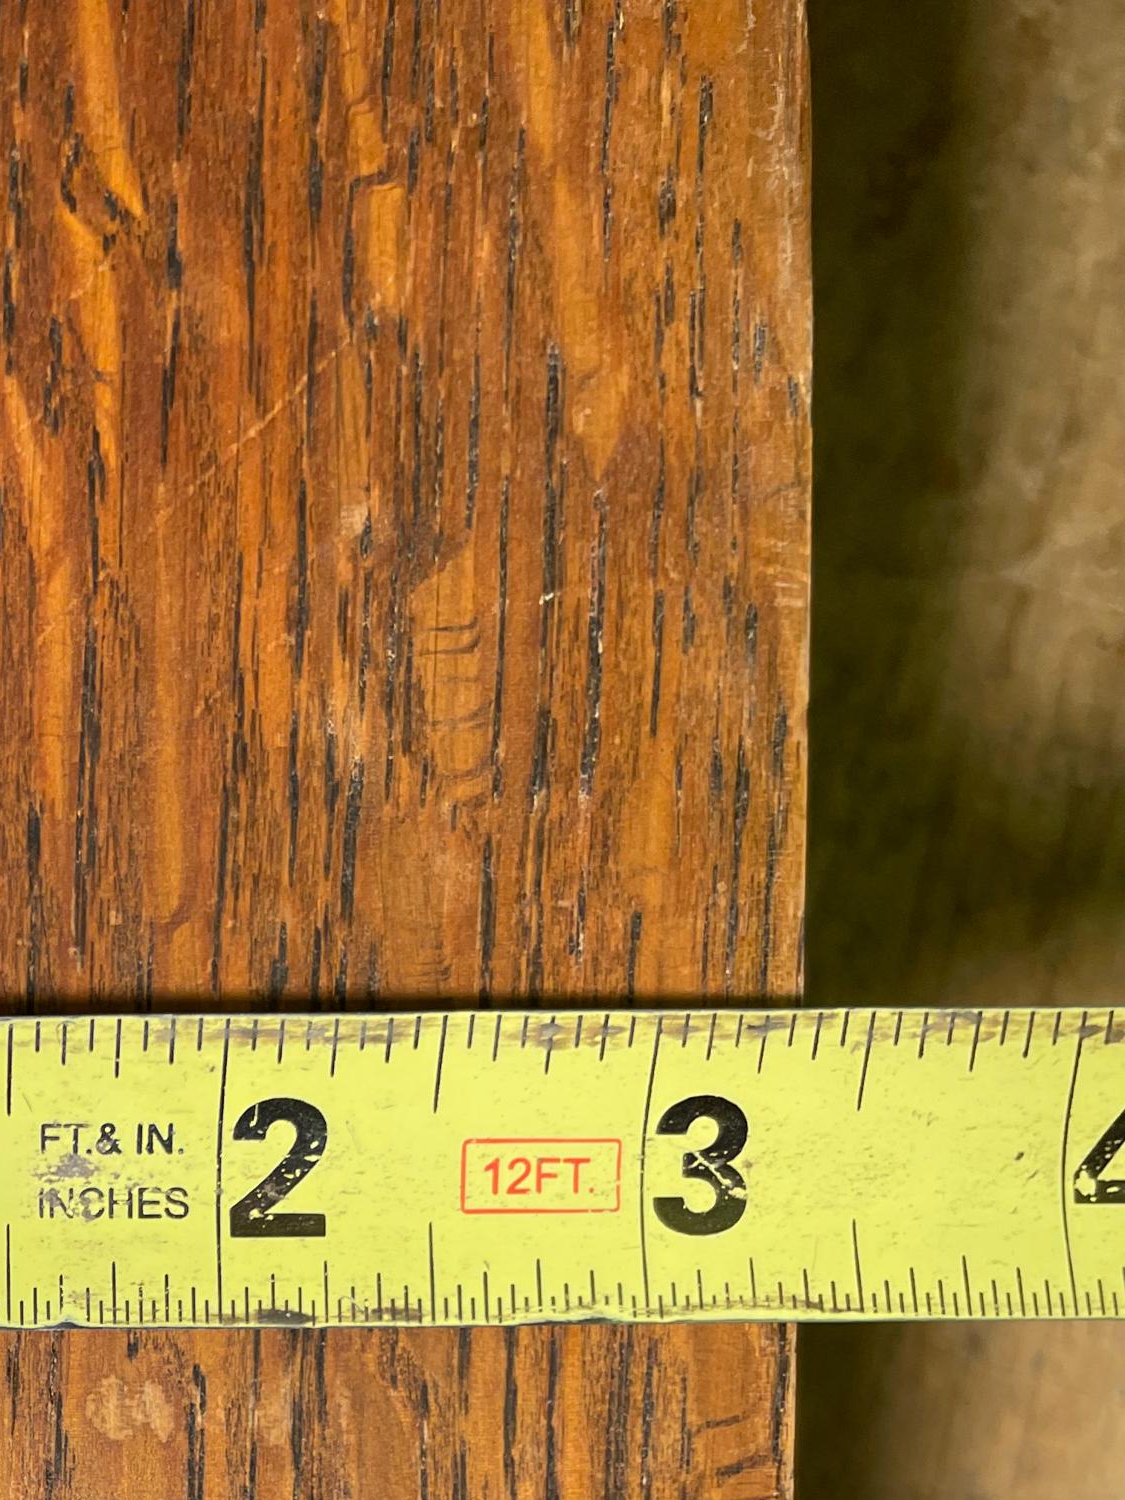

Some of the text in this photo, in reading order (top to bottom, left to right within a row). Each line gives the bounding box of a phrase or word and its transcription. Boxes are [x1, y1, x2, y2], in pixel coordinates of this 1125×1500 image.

[137, 1122, 185, 1155] IN.
[230, 1097, 328, 1238] 2
[483, 1157, 596, 1196] 12FT.
[652, 1094, 749, 1236] 3
[38, 1186, 190, 1220] INCHES
